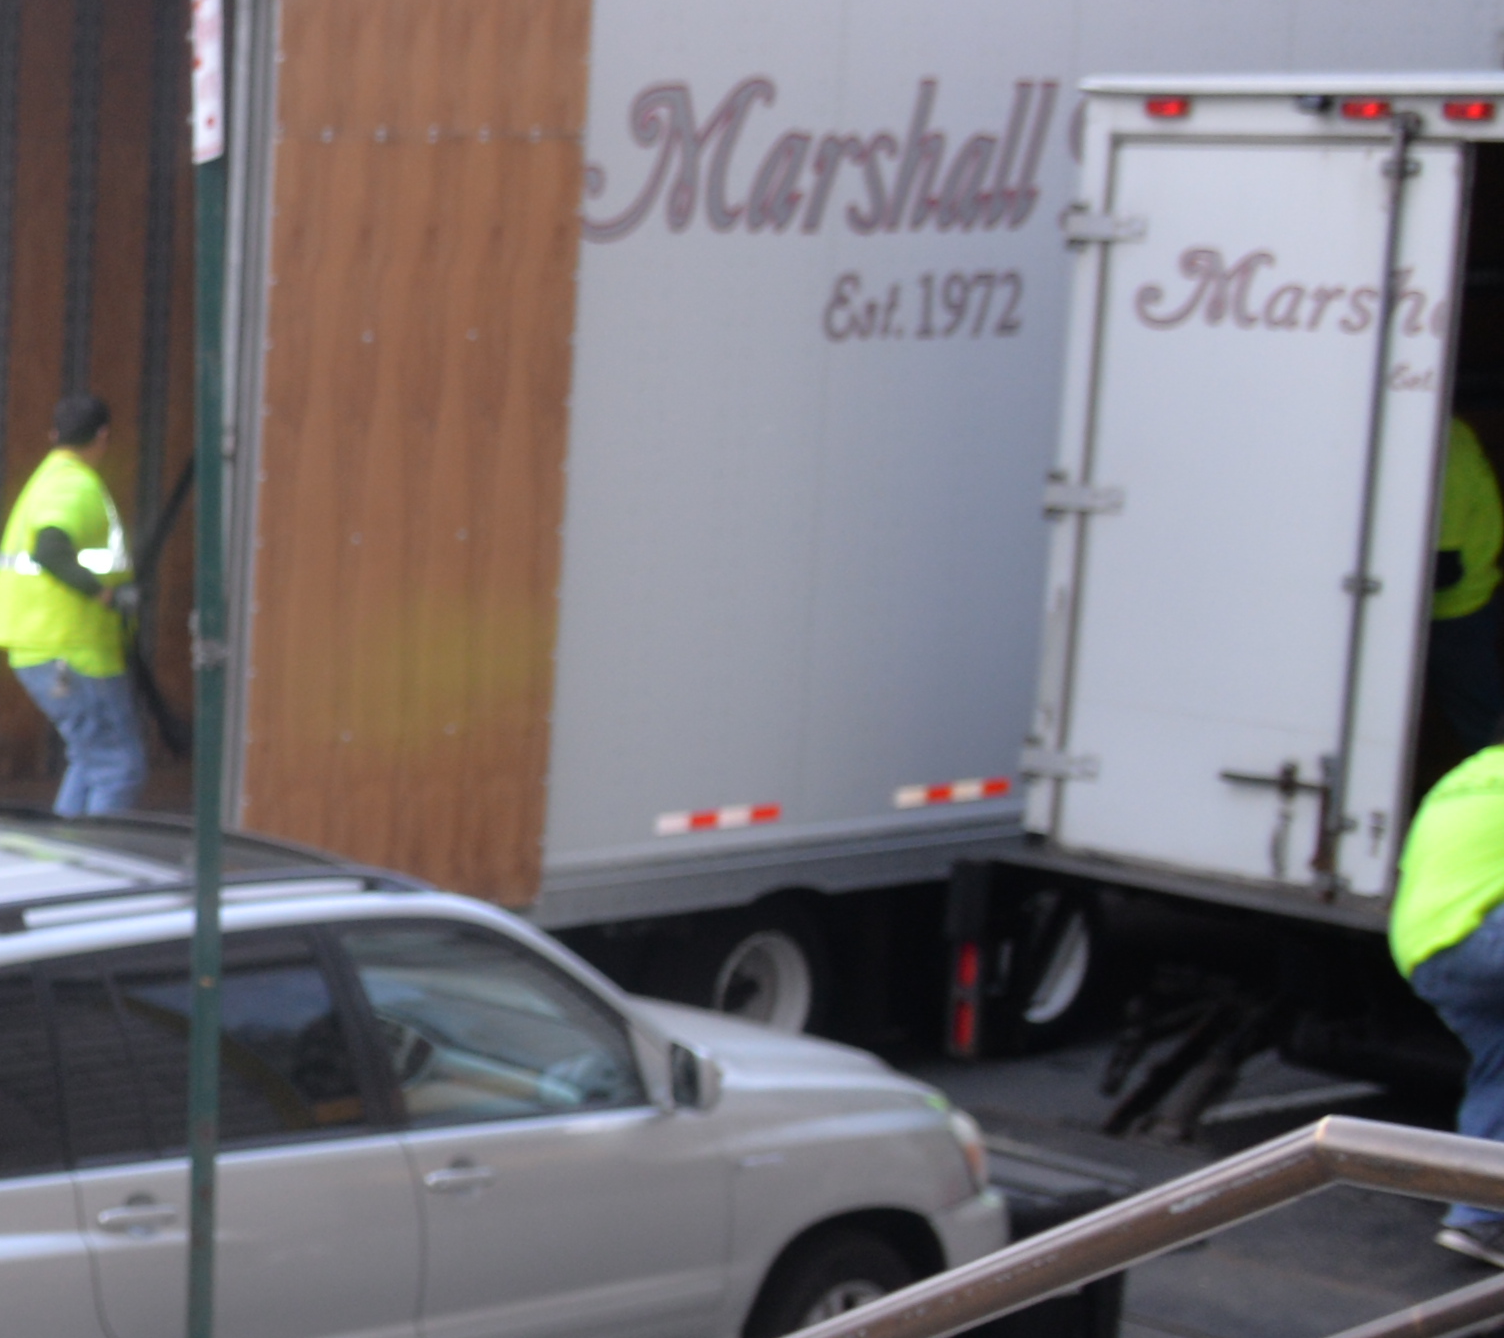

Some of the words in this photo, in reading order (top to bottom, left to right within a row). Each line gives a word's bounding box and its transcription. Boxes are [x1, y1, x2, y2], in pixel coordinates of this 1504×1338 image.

[581, 74, 1060, 244] Marshall
[822, 270, 904, 343] Est.
[915, 269, 1025, 342] 1972
